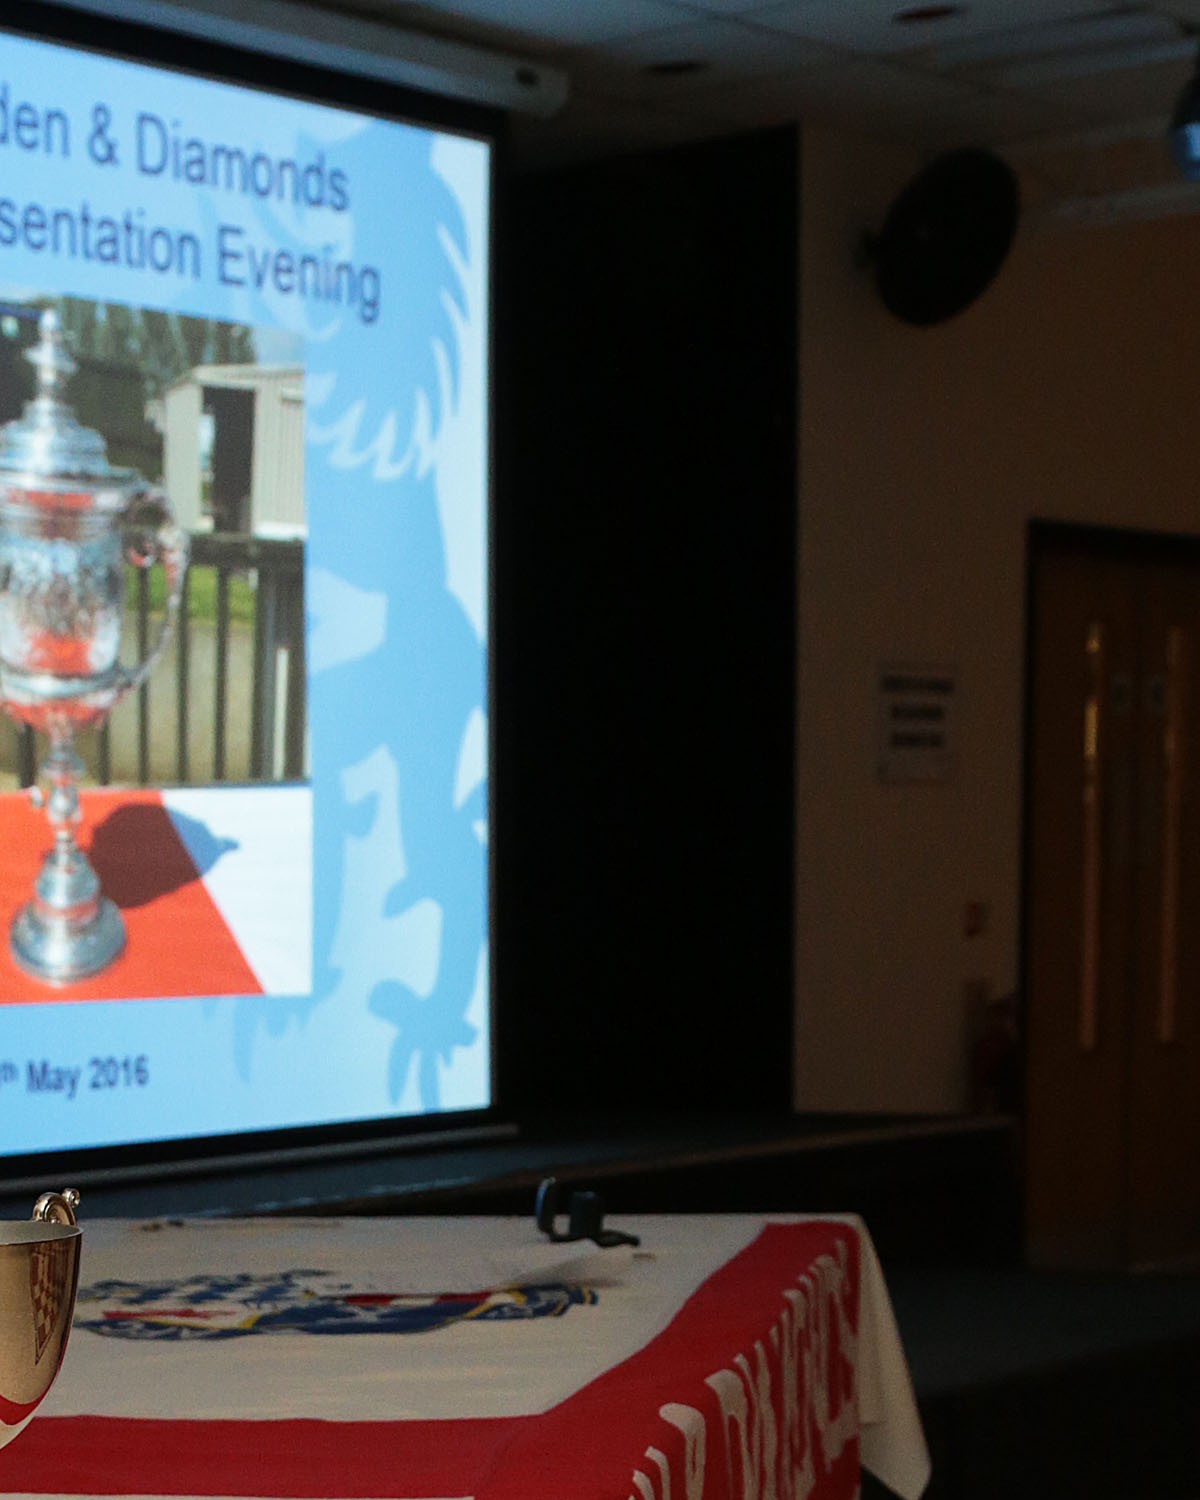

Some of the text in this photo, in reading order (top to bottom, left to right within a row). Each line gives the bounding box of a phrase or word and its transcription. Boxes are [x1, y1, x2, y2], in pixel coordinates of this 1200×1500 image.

[88, 102, 119, 167] &
[138, 112, 349, 212] Diamonds
[218, 224, 382, 323] Evening
[27, 1059, 82, 1099] May
[89, 1055, 149, 1089] 2016
